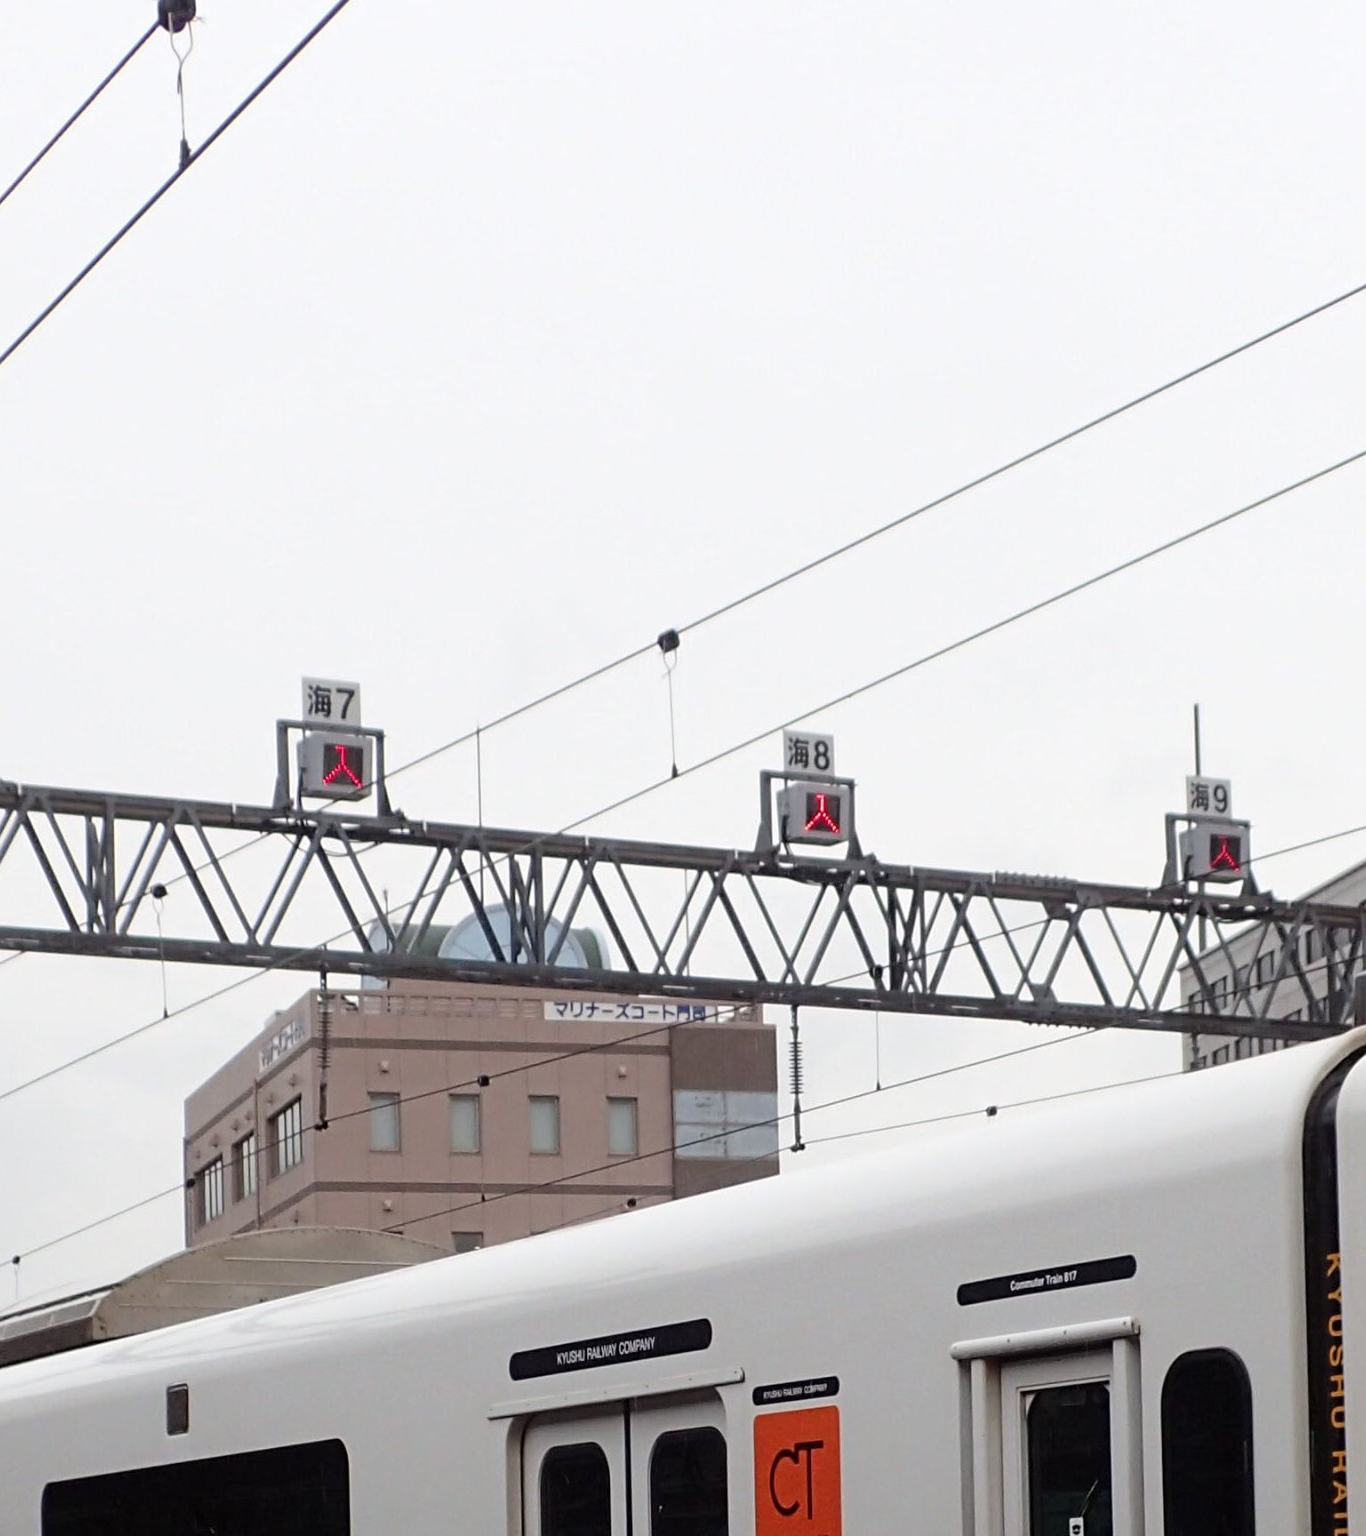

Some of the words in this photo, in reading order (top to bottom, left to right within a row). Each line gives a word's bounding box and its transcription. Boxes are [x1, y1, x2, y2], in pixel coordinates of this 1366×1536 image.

[307, 684, 356, 720] 海7
[787, 737, 831, 771] 海8
[1009, 1277, 1045, 1292] Commuter
[1045, 1272, 1063, 1286] Train
[1063, 1269, 1078, 1284] 817
[556, 1350, 586, 1366] KYUSHU
[586, 1342, 618, 1361] RAILWAY
[618, 1336, 656, 1356] COMPANY
[769, 1440, 824, 1521] CT
